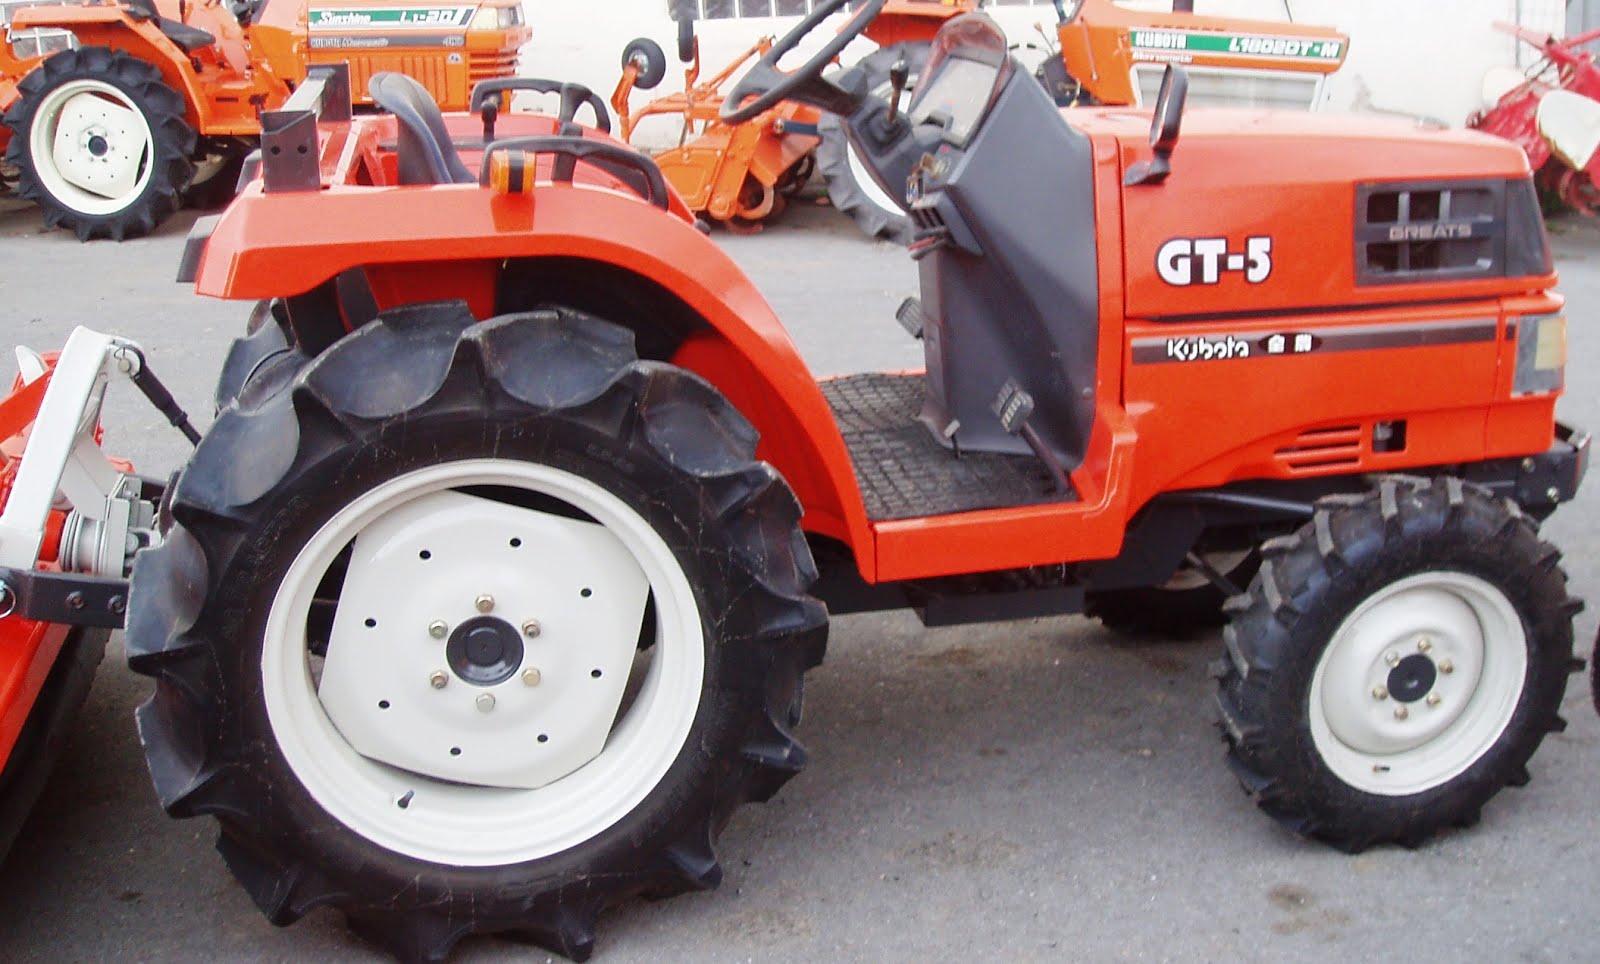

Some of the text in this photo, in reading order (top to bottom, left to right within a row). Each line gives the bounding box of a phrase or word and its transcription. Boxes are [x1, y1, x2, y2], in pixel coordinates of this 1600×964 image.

[319, 11, 372, 25] Sunshine
[1389, 223, 1472, 241] GREATS
[1156, 236, 1272, 287] GT-5
[1166, 335, 1250, 361] Kubota
